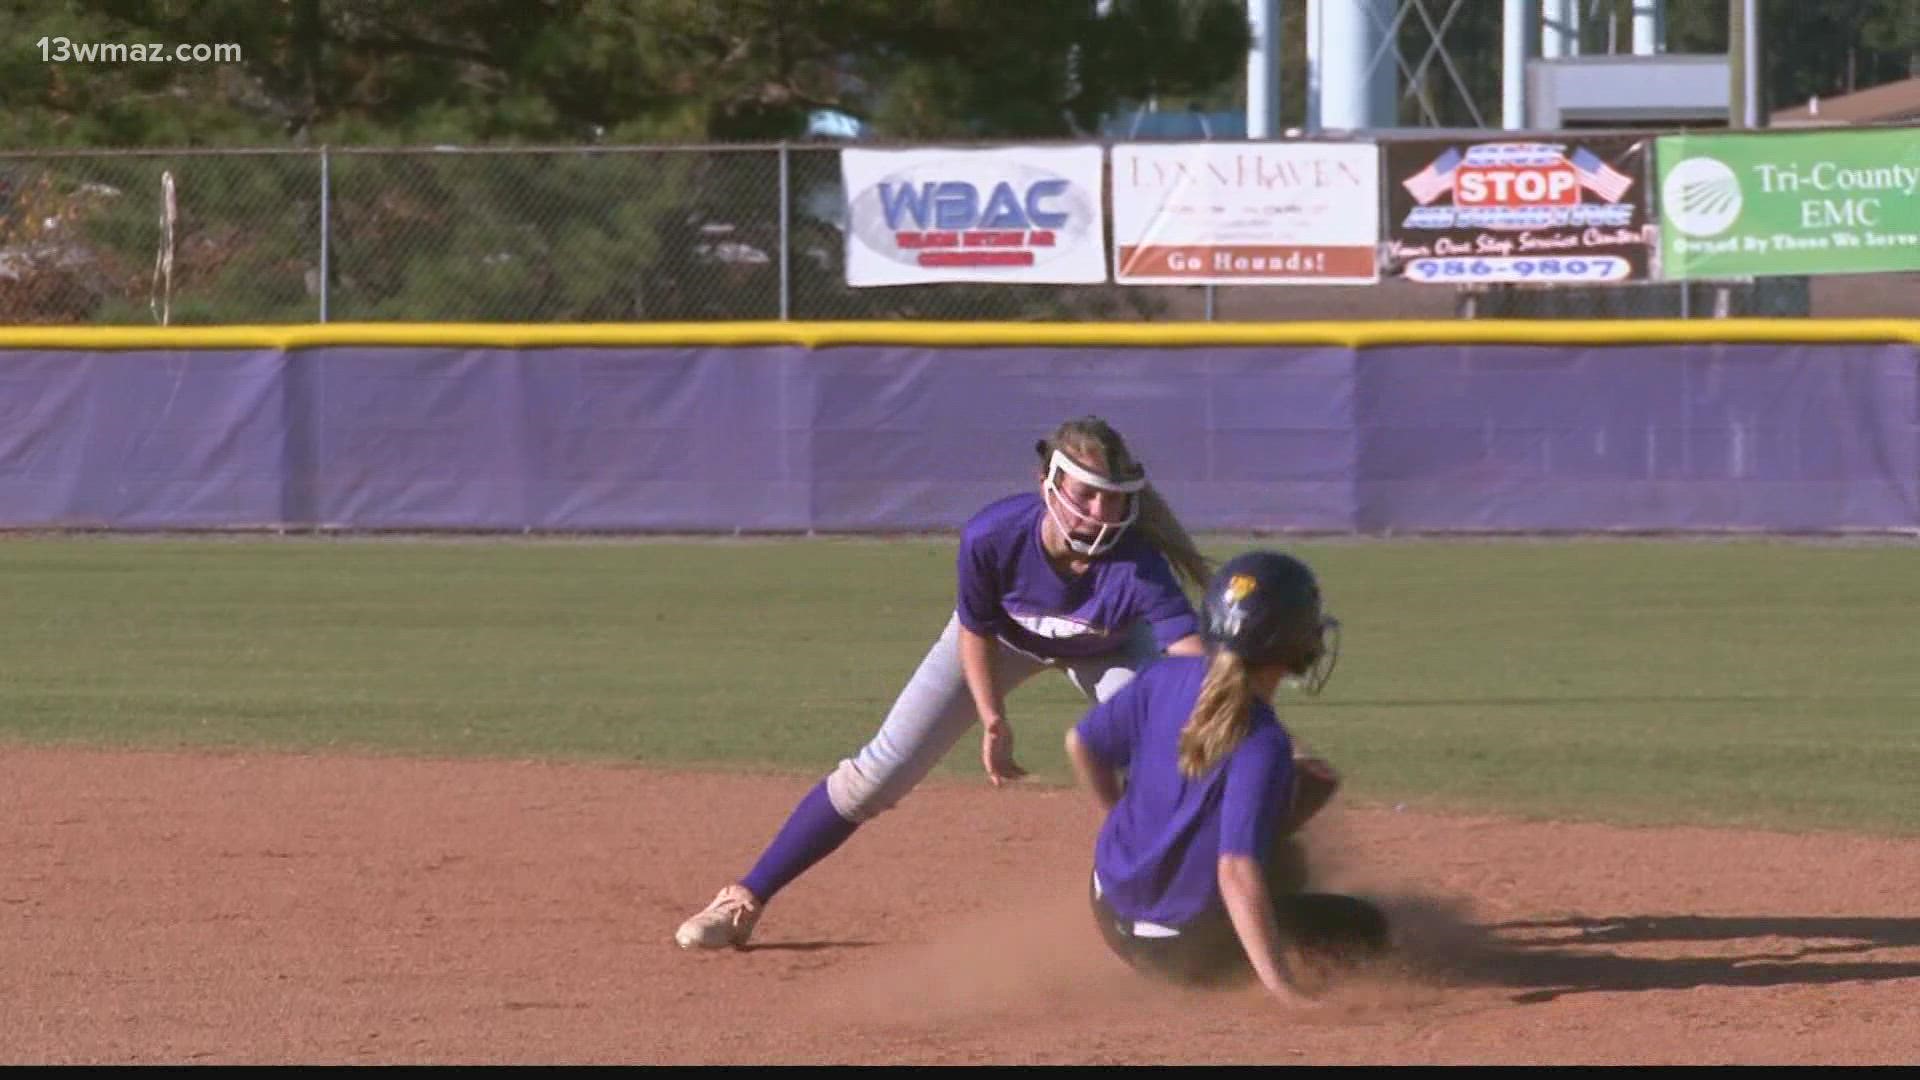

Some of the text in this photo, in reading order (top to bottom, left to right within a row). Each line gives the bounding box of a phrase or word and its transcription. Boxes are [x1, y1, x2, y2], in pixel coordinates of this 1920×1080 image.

[1460, 171, 1575, 200] STOP
[1754, 161, 1919, 196] Tri-County
[878, 179, 1071, 230] WBAC
[1800, 198, 1880, 228] EMC
[1167, 251, 1326, 271] Go Hounds!
[1415, 260, 1616, 276] 986-9807
